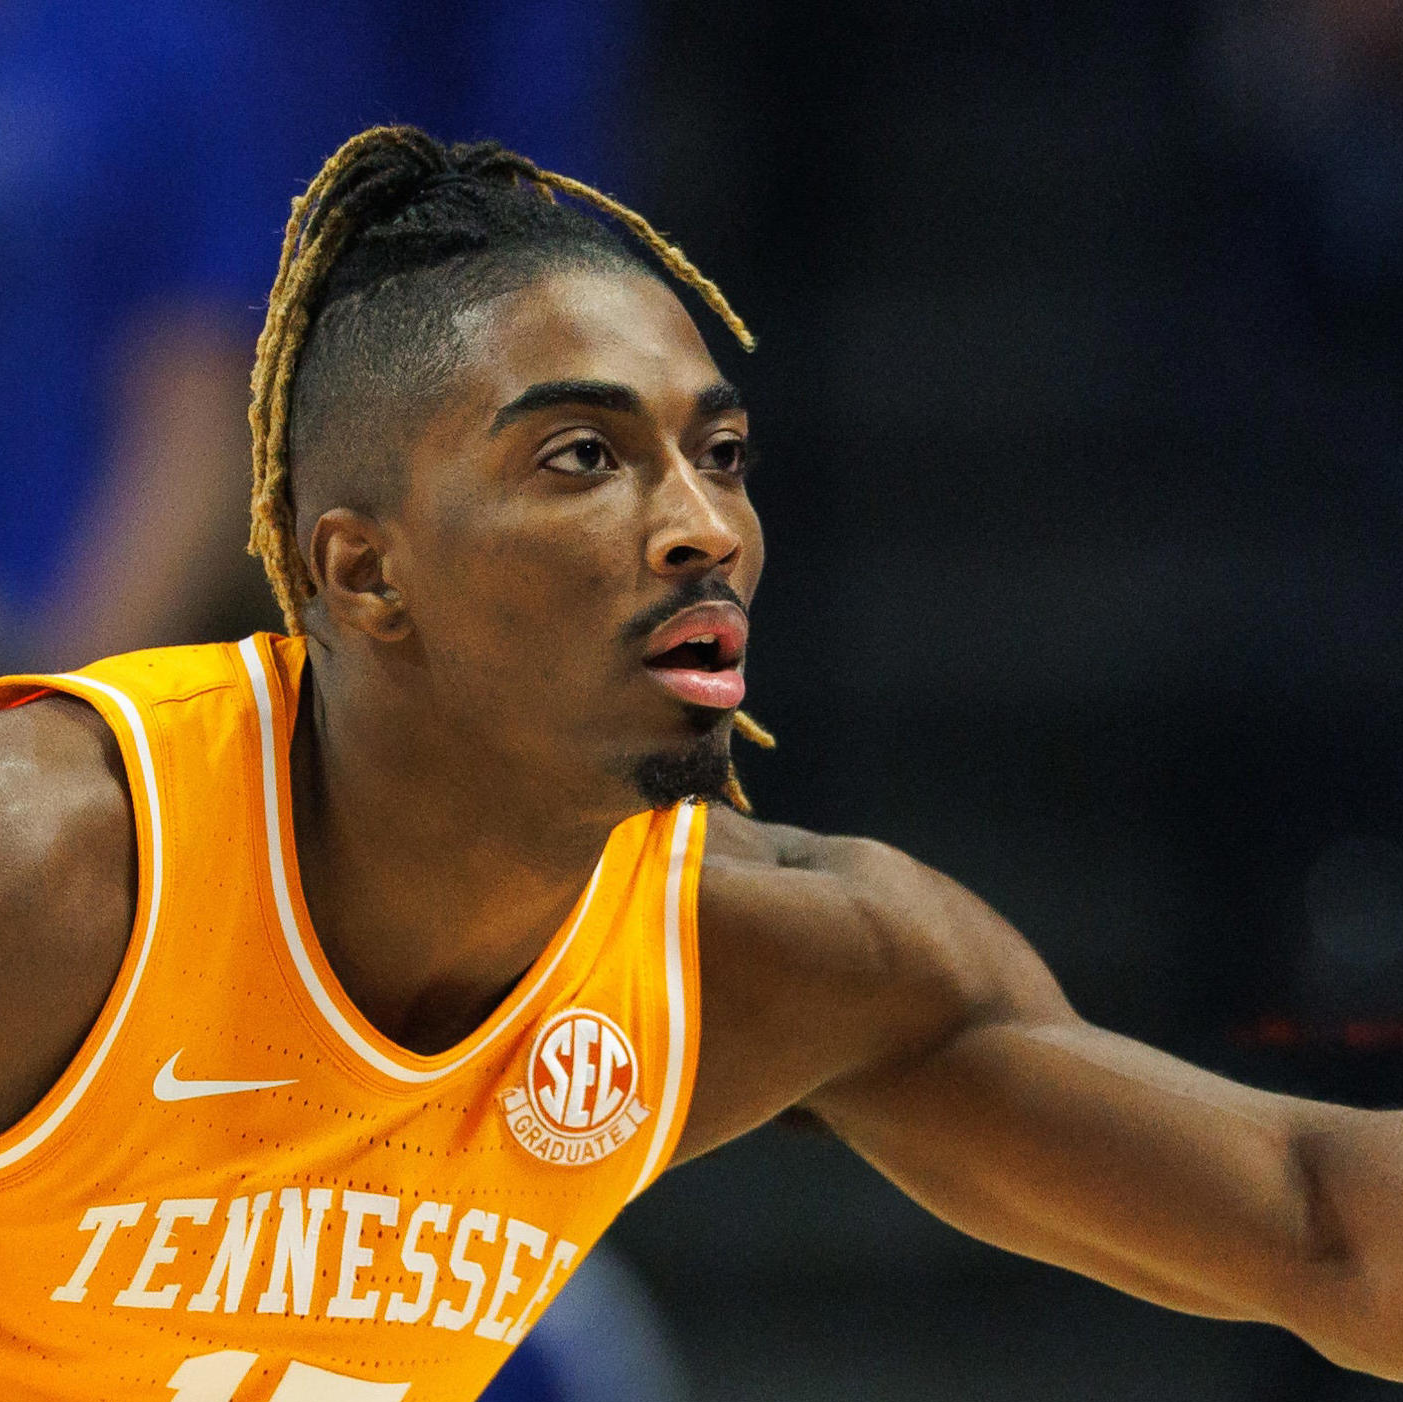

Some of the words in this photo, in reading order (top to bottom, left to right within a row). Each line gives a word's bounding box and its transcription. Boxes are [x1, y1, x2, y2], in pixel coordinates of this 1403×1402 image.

[538, 1017, 630, 1129] SEC
[513, 1114, 625, 1163] GRADUATE
[51, 1187, 579, 1345] TENNESSEE
